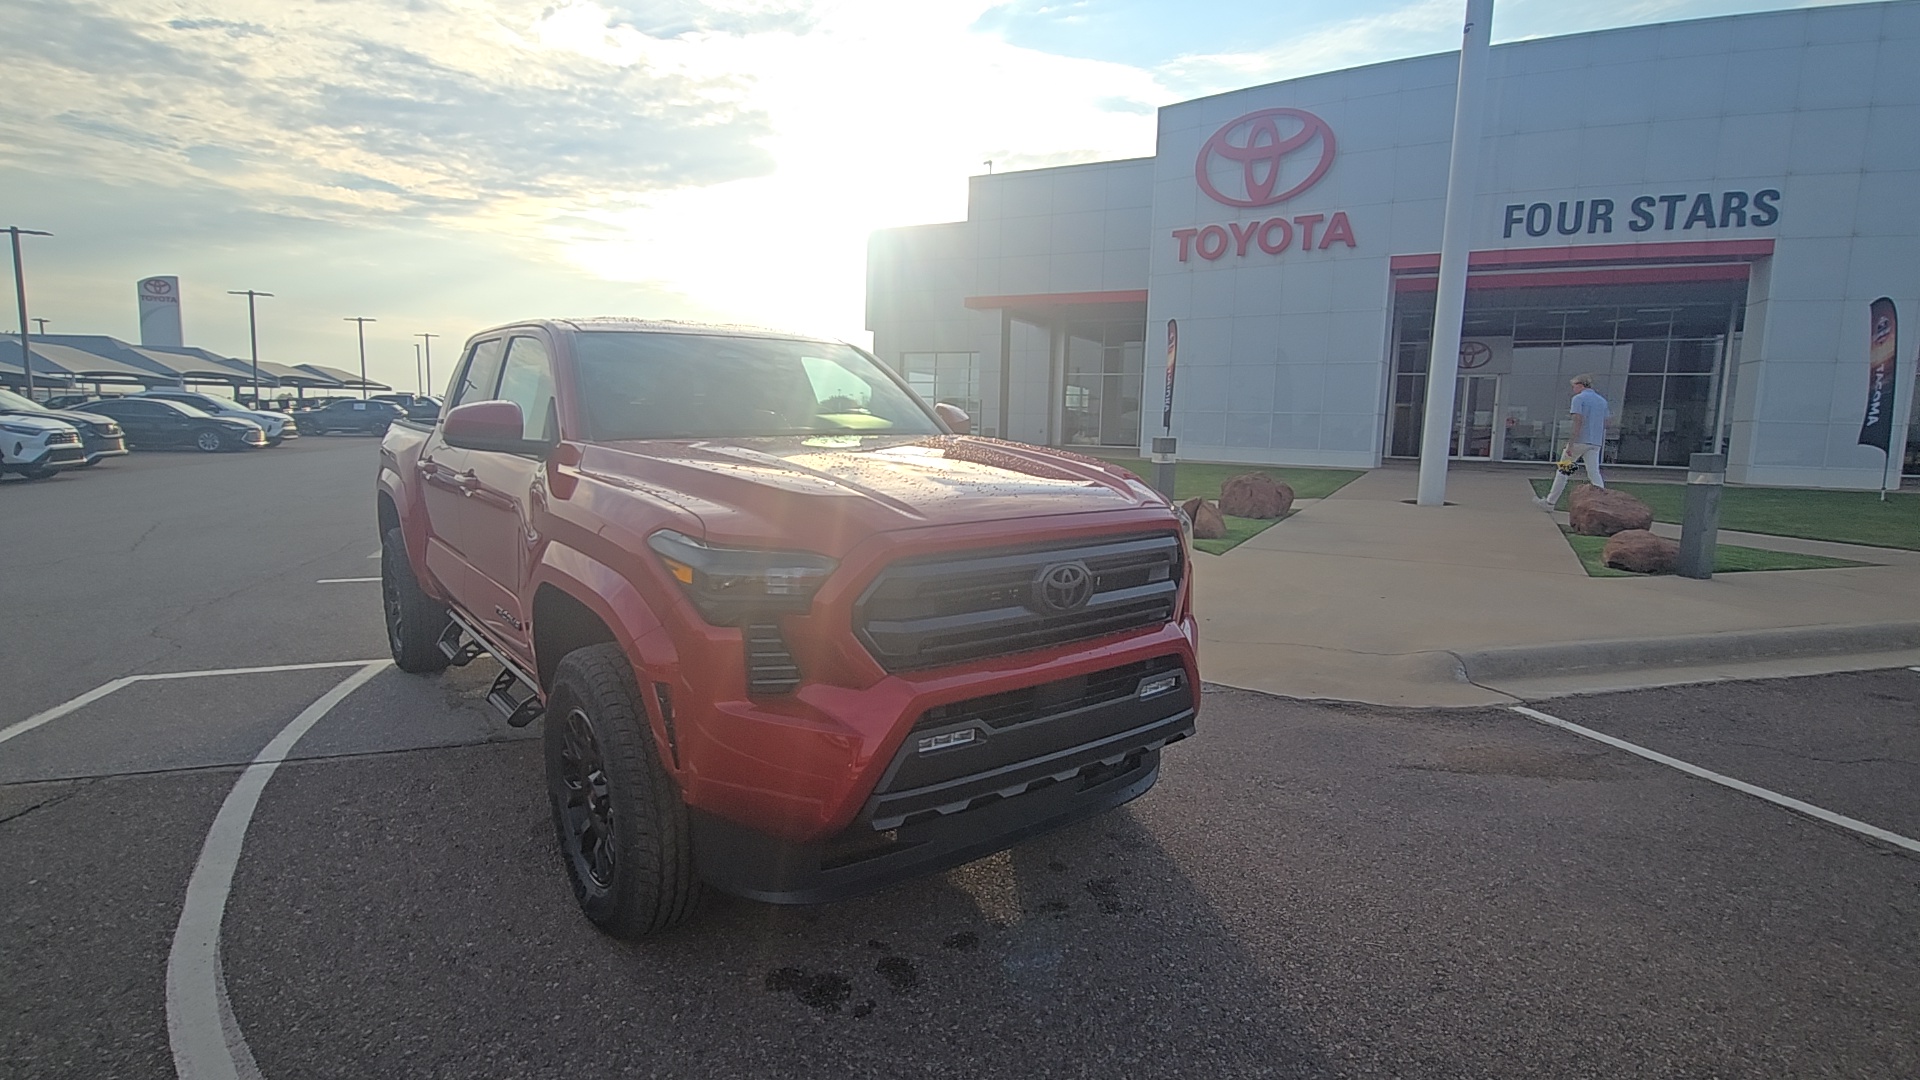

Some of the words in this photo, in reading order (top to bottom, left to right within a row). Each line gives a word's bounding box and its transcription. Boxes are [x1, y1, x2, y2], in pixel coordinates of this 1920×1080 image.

[1172, 212, 1356, 261] TOYOTA
[1503, 199, 1614, 238] FOUR
[1629, 189, 1780, 232] STARS
[140, 295, 177, 303] TOYOTA
[1867, 364, 1884, 426] TACOMA
